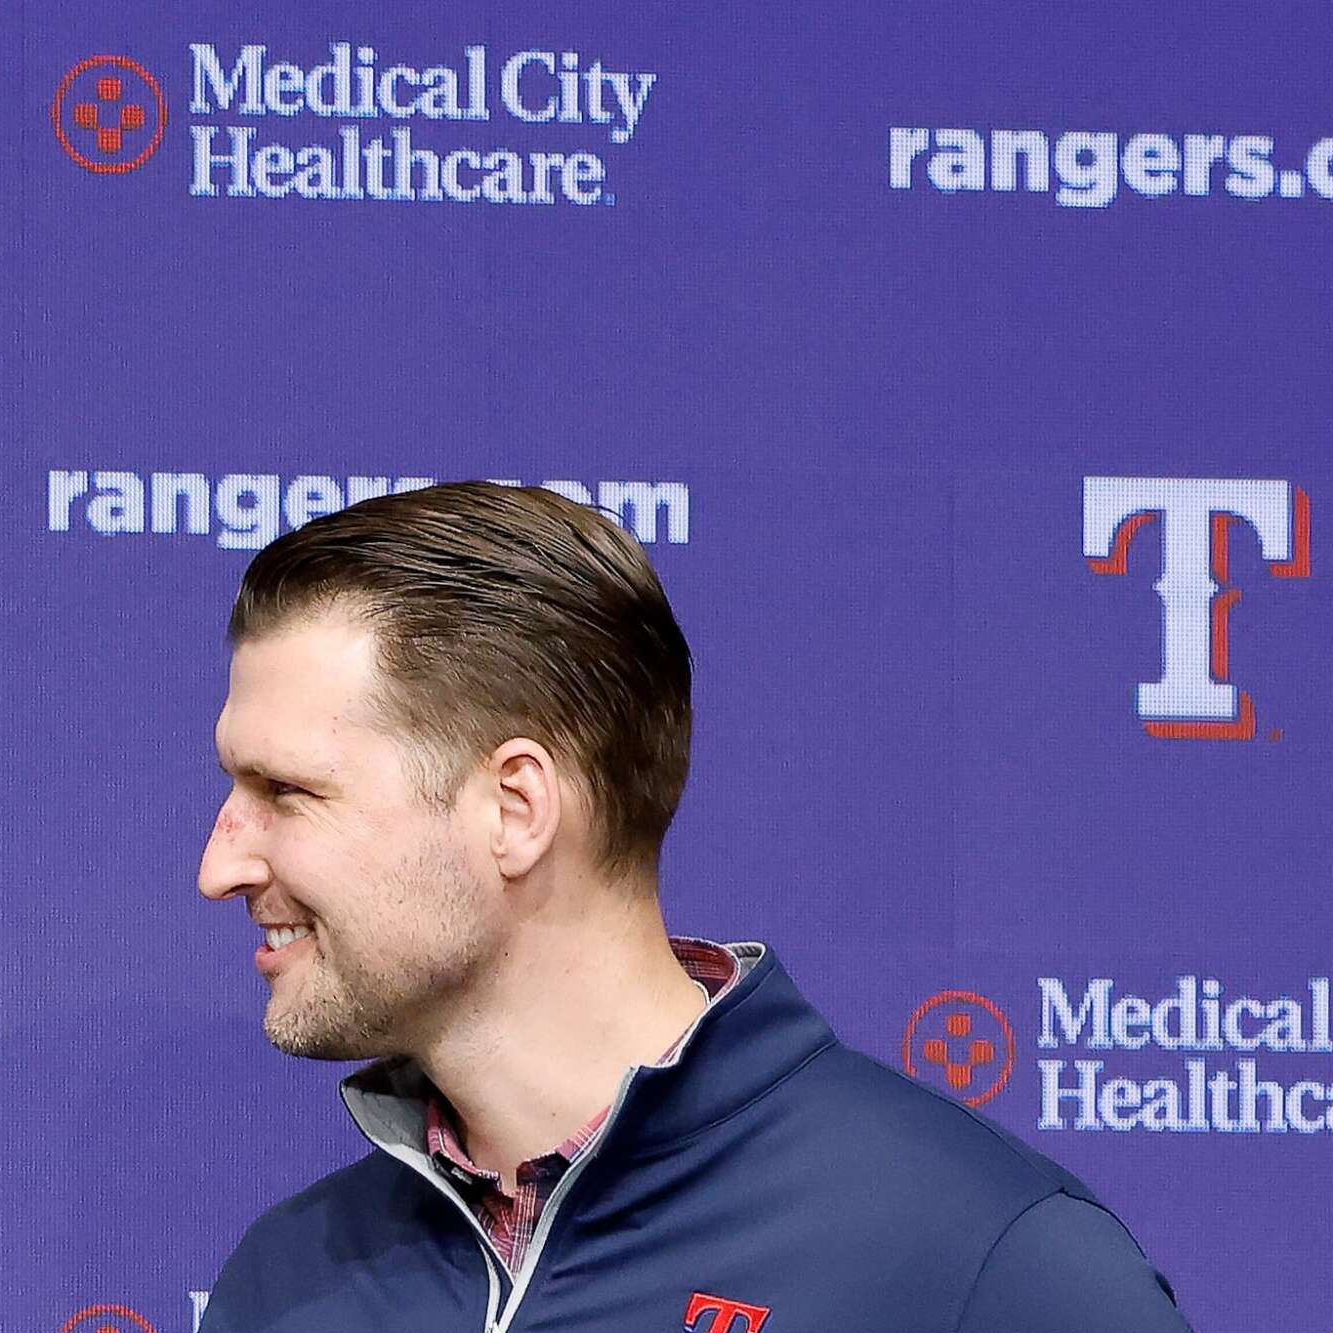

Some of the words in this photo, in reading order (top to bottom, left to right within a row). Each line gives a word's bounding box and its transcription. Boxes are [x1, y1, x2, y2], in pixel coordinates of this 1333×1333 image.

[189, 42, 490, 121] Medical
[501, 50, 657, 144] City
[189, 125, 607, 206] Healthcare
[1083, 476, 1311, 741] T
[1037, 975, 1333, 1053] Medical
[1037, 1058, 1333, 1133] Healthc
